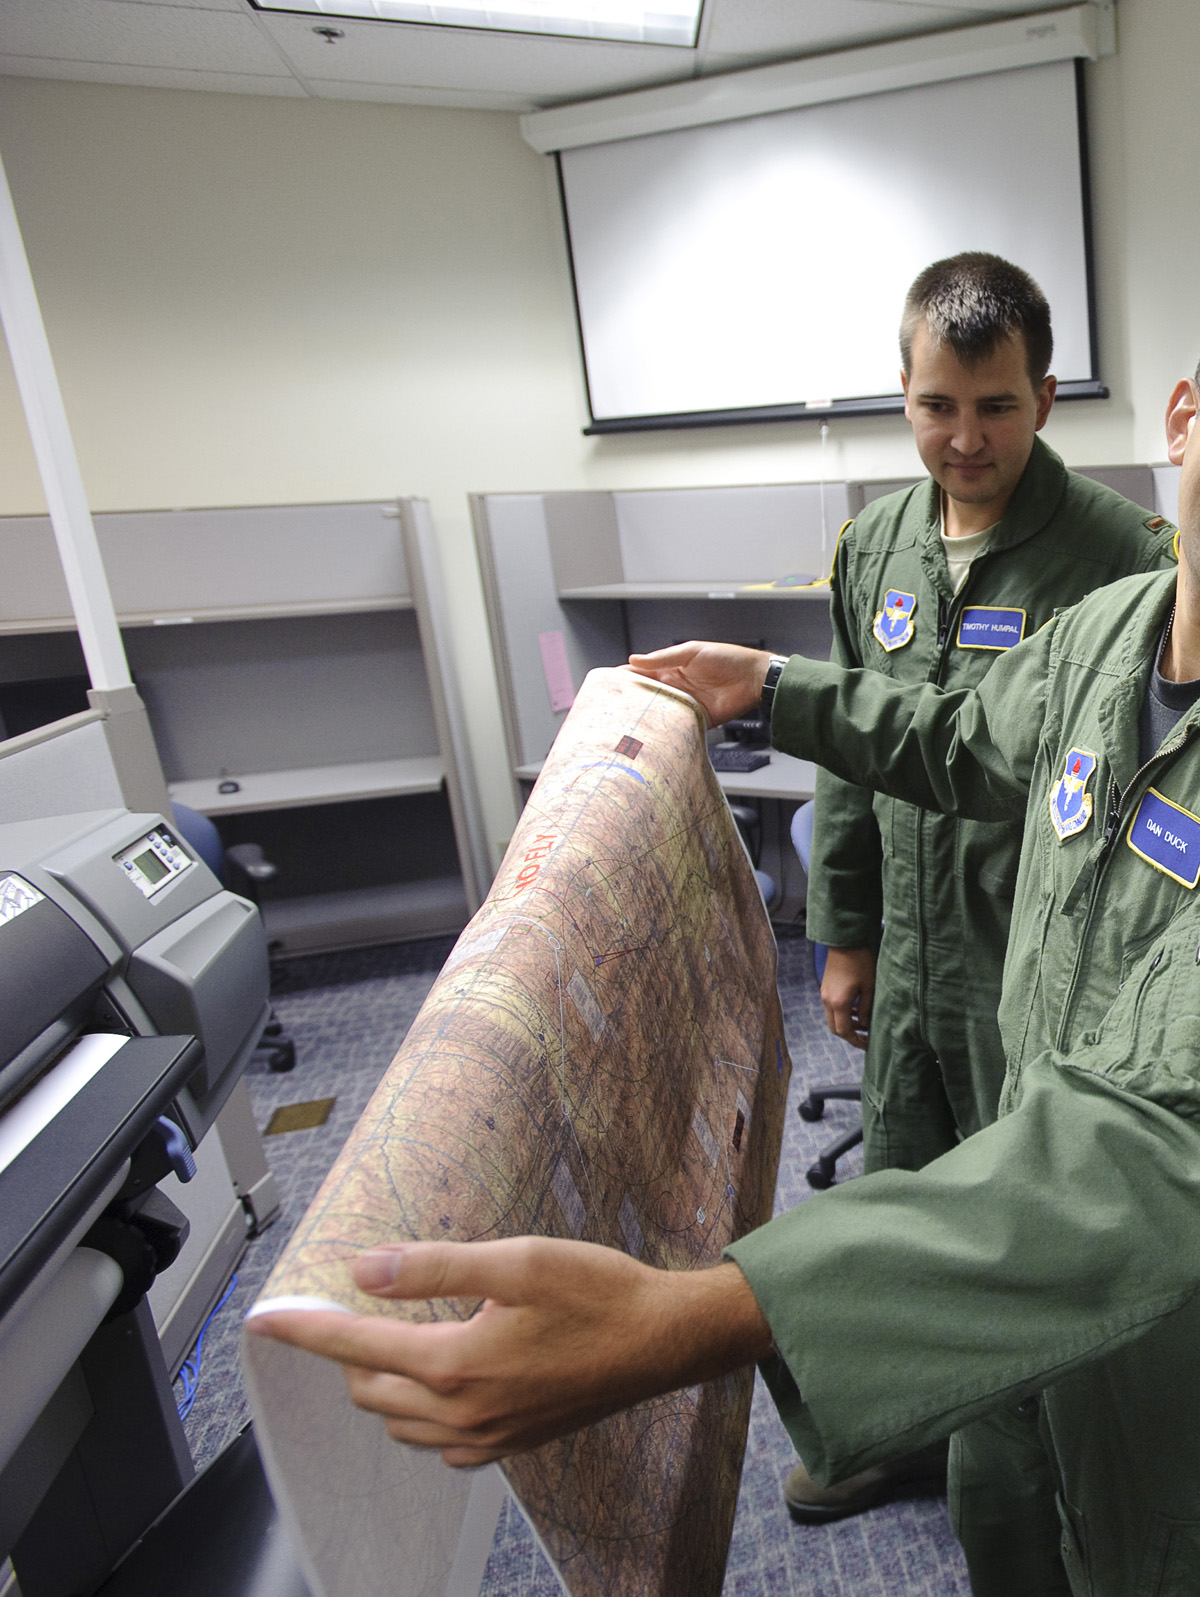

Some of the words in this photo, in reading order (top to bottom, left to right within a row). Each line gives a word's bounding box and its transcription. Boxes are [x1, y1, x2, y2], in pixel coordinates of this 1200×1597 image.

[962, 622, 989, 631] TIMOTHY
[1146, 819, 1162, 837] DAN
[1164, 831, 1188, 854] DUCK
